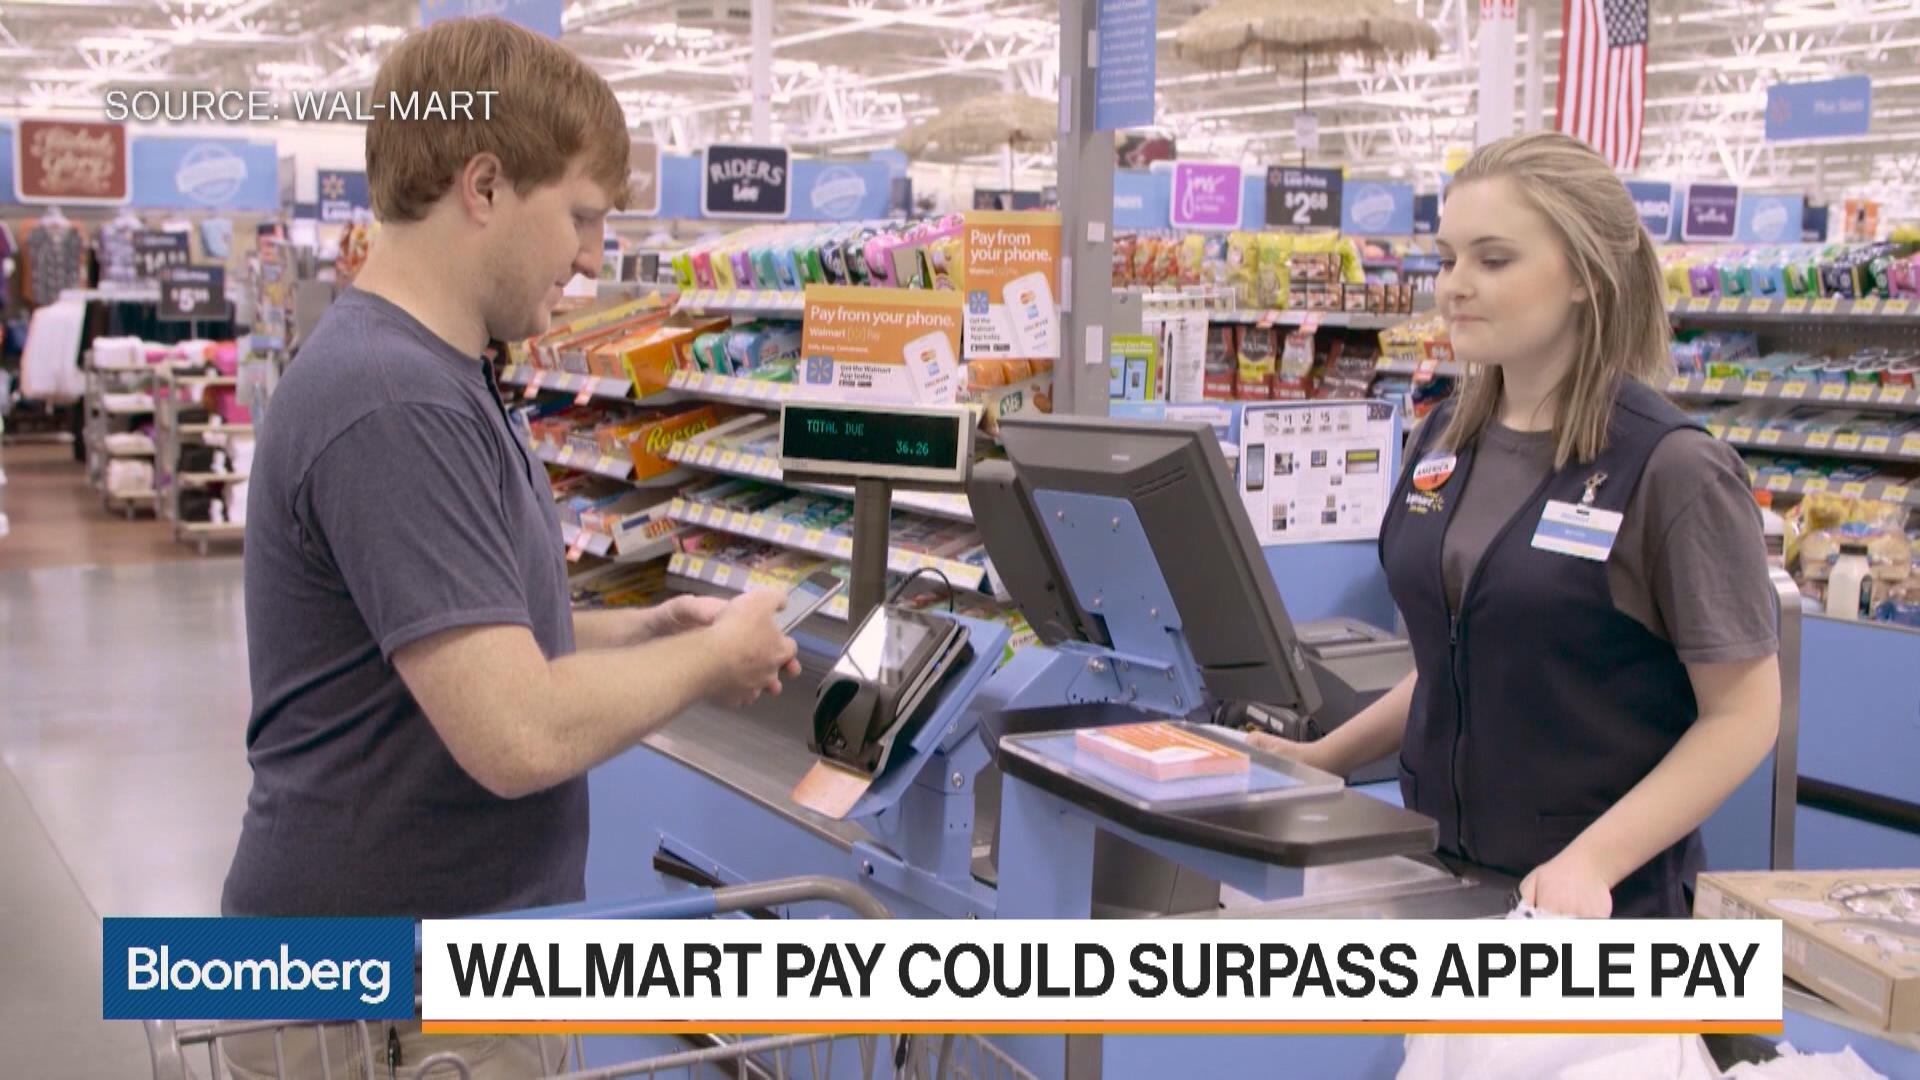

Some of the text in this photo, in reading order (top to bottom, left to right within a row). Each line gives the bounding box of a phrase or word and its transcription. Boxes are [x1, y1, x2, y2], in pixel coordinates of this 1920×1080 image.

[709, 158, 785, 187] RIDERS
[970, 228, 1031, 248] Pay from
[971, 246, 1053, 265] your phone.
[811, 305, 955, 328] Pay from your phone.
[809, 327, 846, 339] Walmart
[807, 418, 865, 437] TOTAL DUE
[895, 440, 930, 457] 36.26
